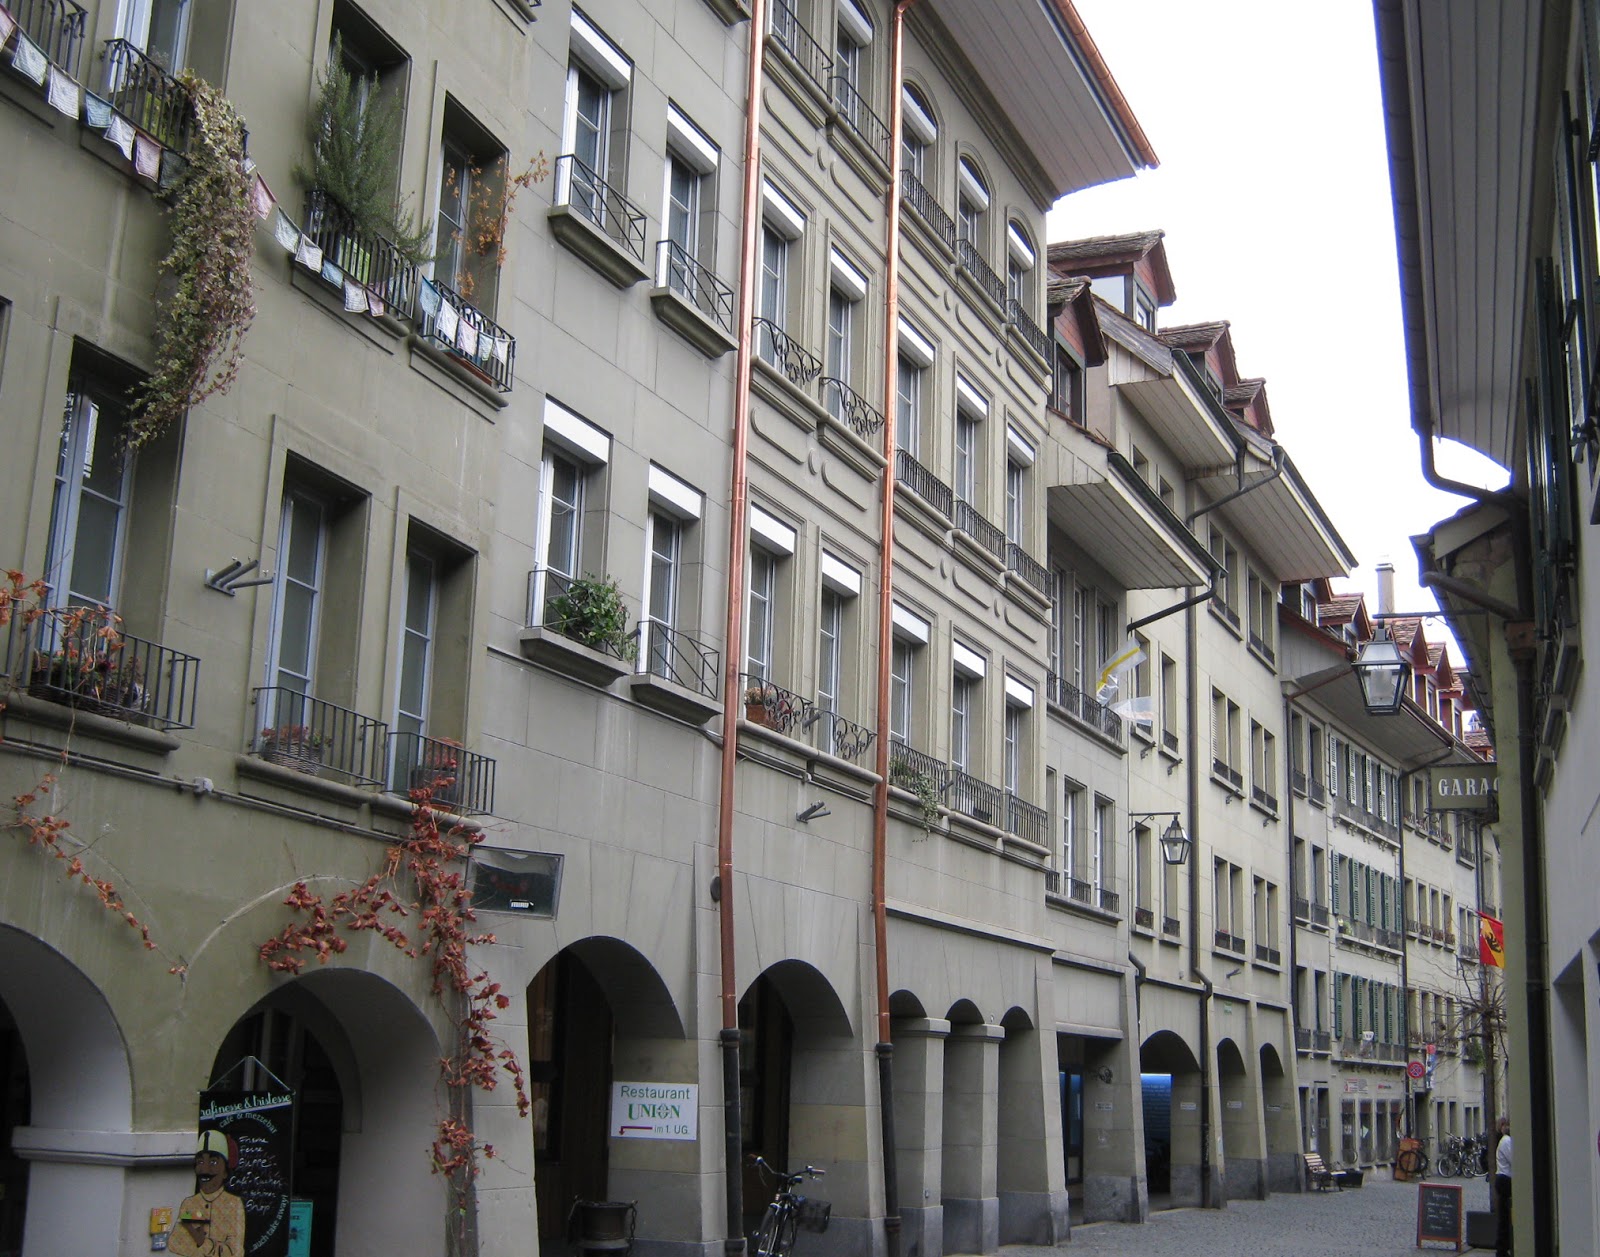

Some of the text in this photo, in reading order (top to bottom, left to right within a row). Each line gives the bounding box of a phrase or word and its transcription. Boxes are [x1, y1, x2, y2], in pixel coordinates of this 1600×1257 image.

[620, 1085, 690, 1100] Restaurant
[244, 1097, 252, 1109] &
[628, 1103, 681, 1121] UNION
[245, 1111, 278, 1134] mezzebar
[654, 1124, 664, 1133] im
[266, 1219, 279, 1236] take
